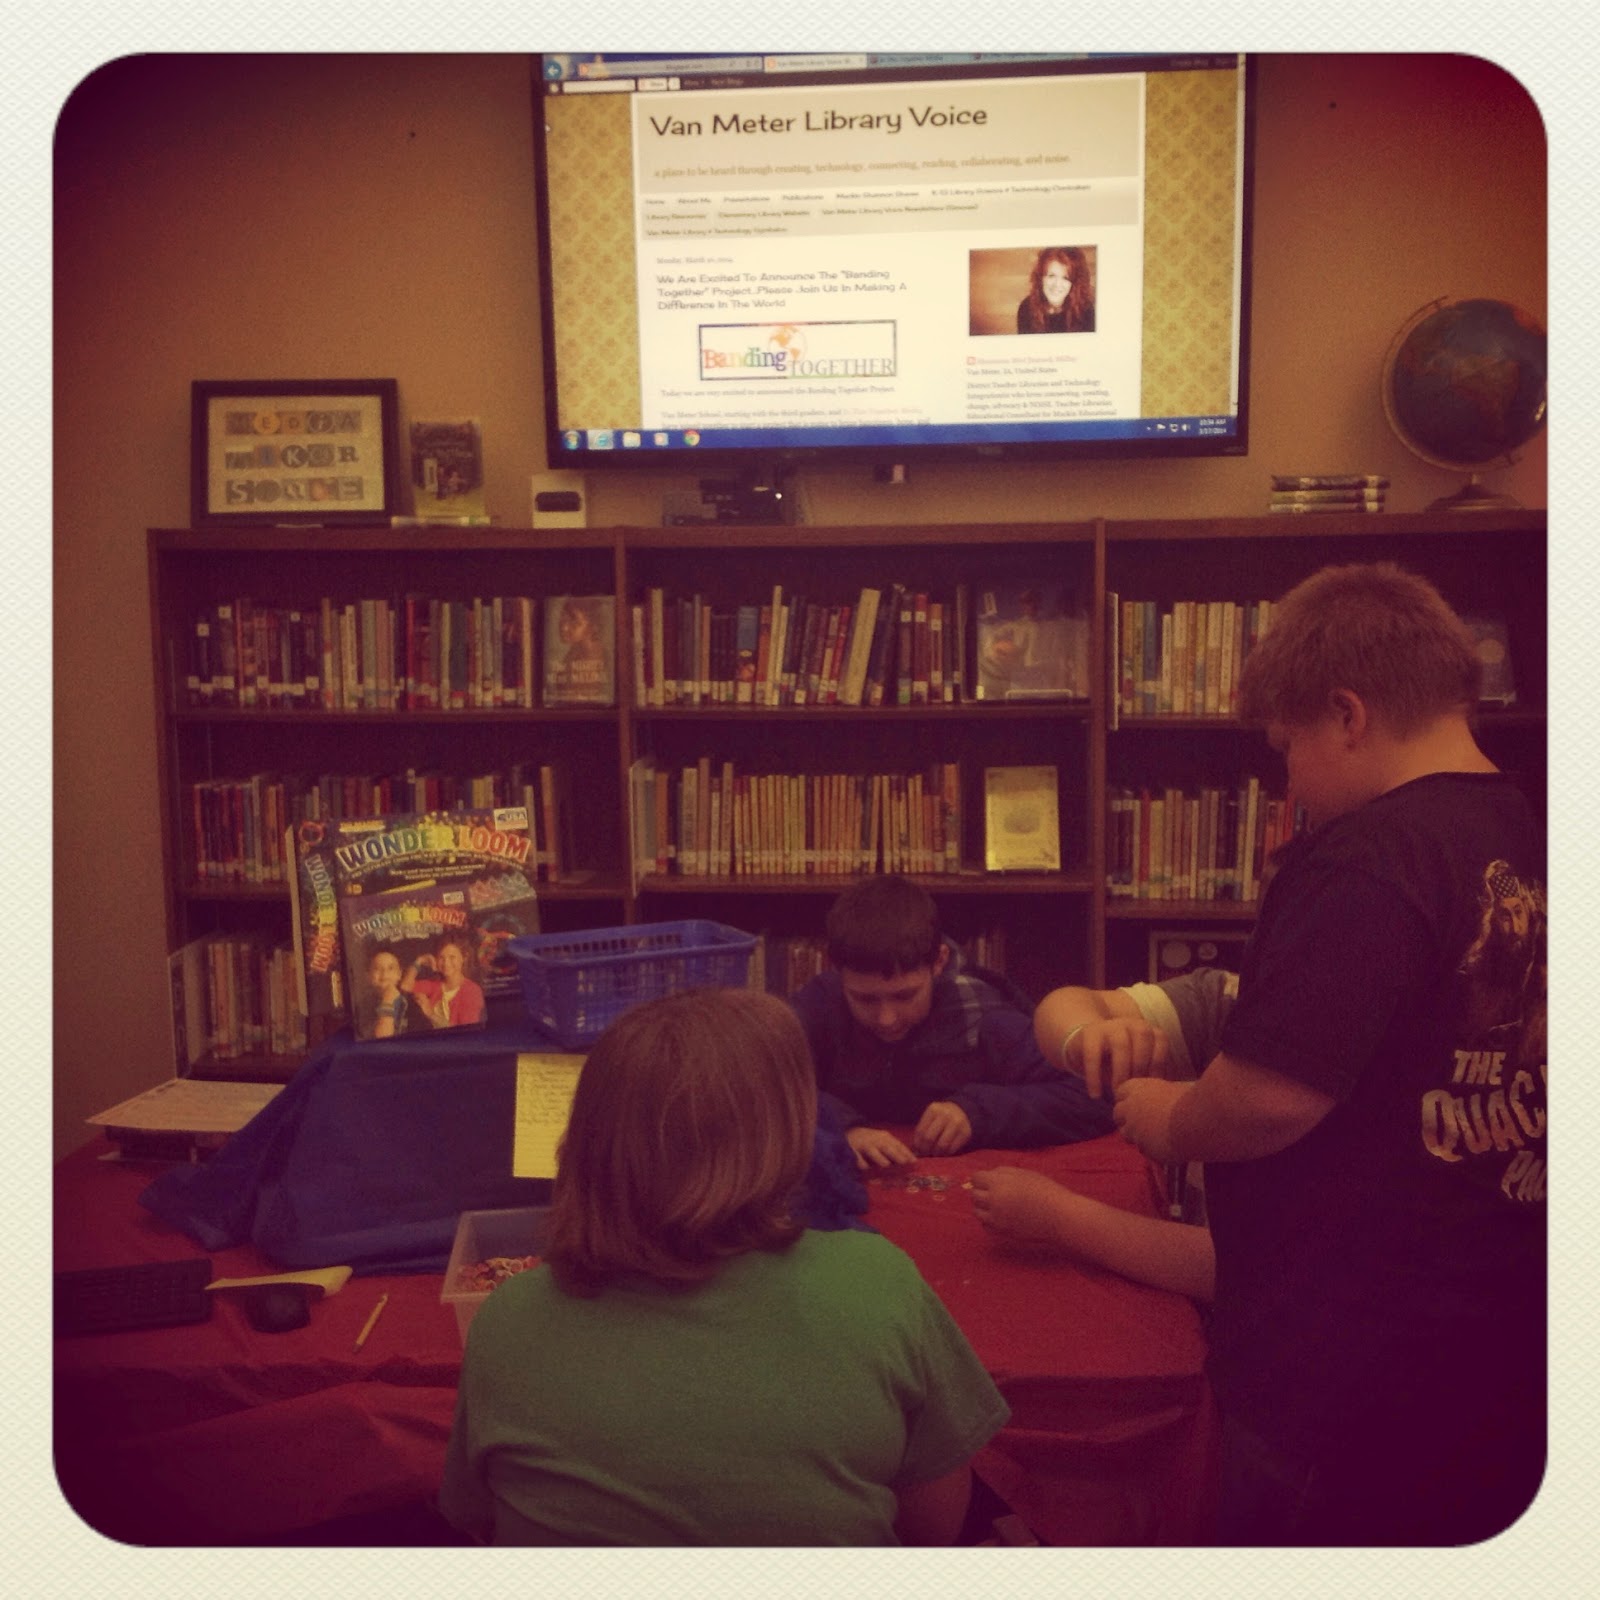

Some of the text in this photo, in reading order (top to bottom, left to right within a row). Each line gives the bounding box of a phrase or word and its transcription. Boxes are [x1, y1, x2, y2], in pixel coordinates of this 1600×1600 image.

[649, 105, 988, 136] Van Meter Library Voice
[709, 163, 737, 176] heard
[737, 162, 772, 178] through
[1023, 153, 1042, 165] and
[656, 274, 674, 284] We
[678, 273, 697, 283] Are
[700, 272, 740, 282] Excited
[743, 272, 757, 281] To
[760, 270, 815, 281] Announce
[819, 270, 838, 280] The
[797, 284, 820, 293] Join
[823, 283, 839, 292] Us
[841, 283, 852, 291] In
[854, 282, 896, 294] Making
[899, 281, 907, 290] A
[657, 298, 786, 310] Difference In The World
[703, 347, 788, 371] Banding
[790, 358, 894, 376] TOGETHER
[458, 825, 532, 863] LOOM
[423, 907, 467, 928] LOOM
[310, 924, 338, 972] LOOM
[1452, 1050, 1507, 1085] THE
[1421, 1064, 1547, 1162] QUAC
